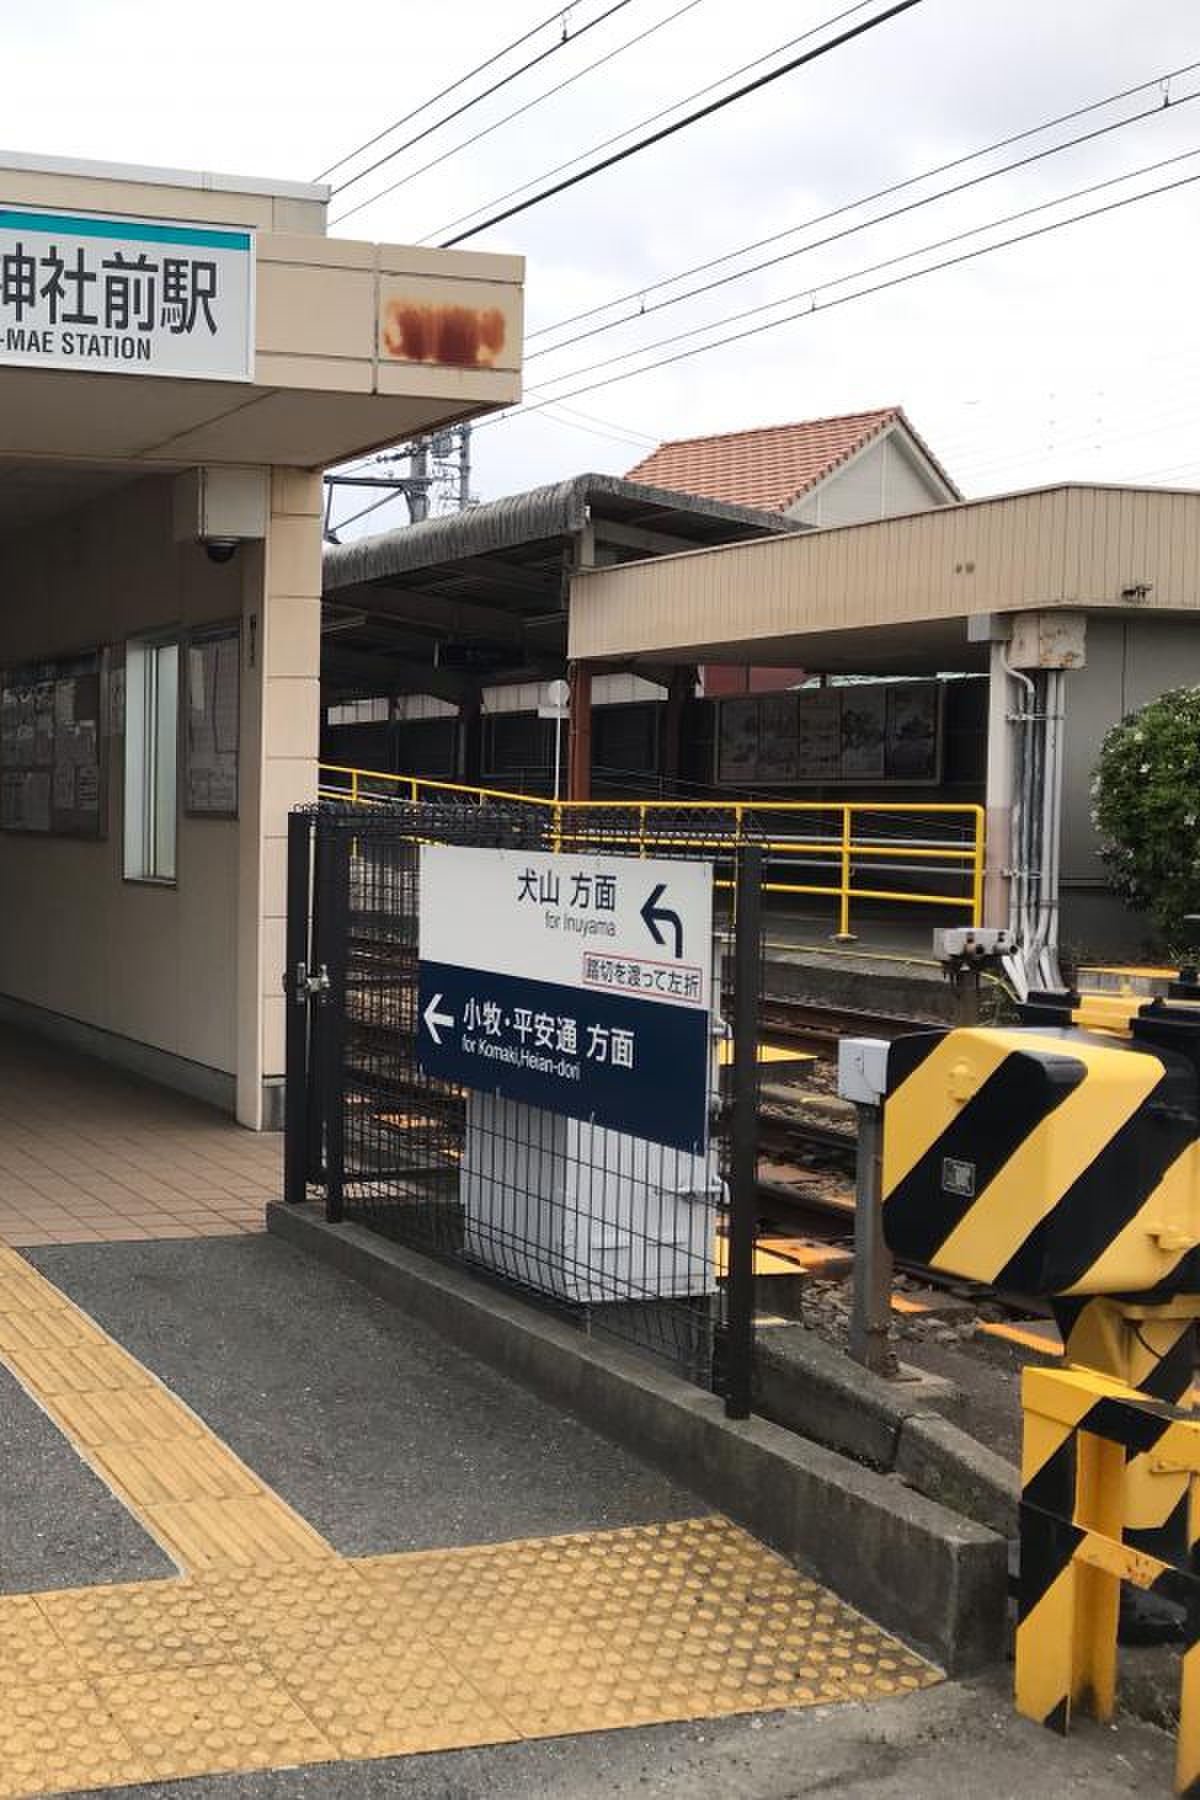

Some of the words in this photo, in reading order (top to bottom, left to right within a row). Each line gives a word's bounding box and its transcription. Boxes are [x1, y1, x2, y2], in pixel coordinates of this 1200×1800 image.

[60, 331, 153, 361] STATION
[517, 867, 560, 907] 犬山
[569, 872, 618, 912] 方面
[545, 911, 561, 930] for
[563, 912, 616, 937] Inuyama
[461, 1034, 477, 1053] for
[463, 997, 578, 1055] 小牧・平安通
[586, 1023, 635, 1069] 方面
